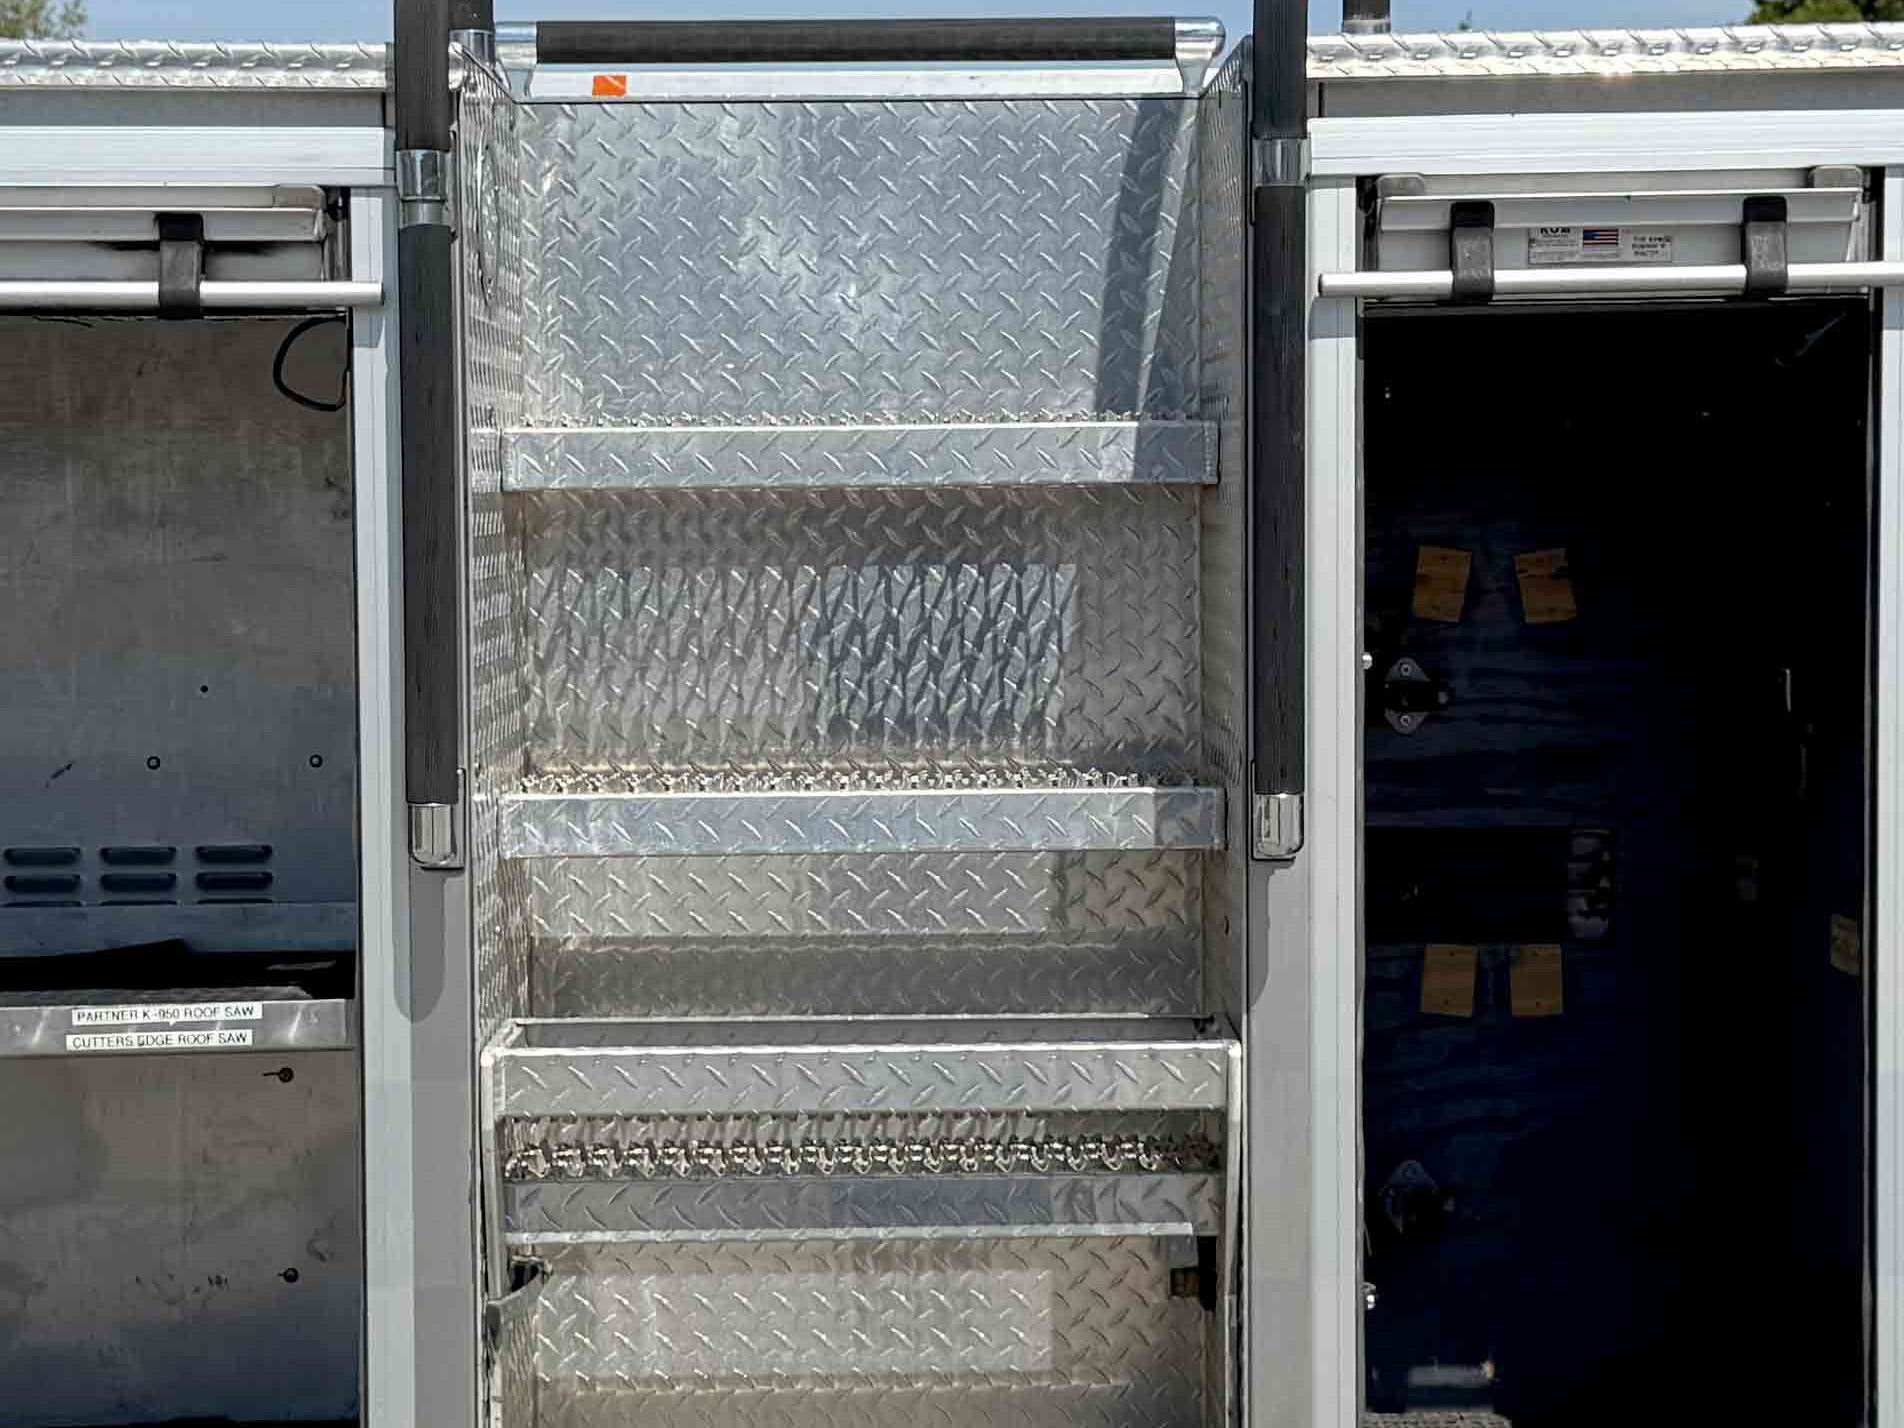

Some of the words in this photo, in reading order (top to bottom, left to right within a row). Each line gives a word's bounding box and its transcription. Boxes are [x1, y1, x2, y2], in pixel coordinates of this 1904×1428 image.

[77, 1008, 138, 1022] PARTNER
[184, 1006, 220, 1019] ROOF
[224, 1005, 255, 1018] SAW
[72, 1036, 134, 1049] CUTTERS
[136, 1035, 175, 1047] EDGE
[178, 1034, 214, 1046] ROOF
[218, 1032, 248, 1044] SAW
